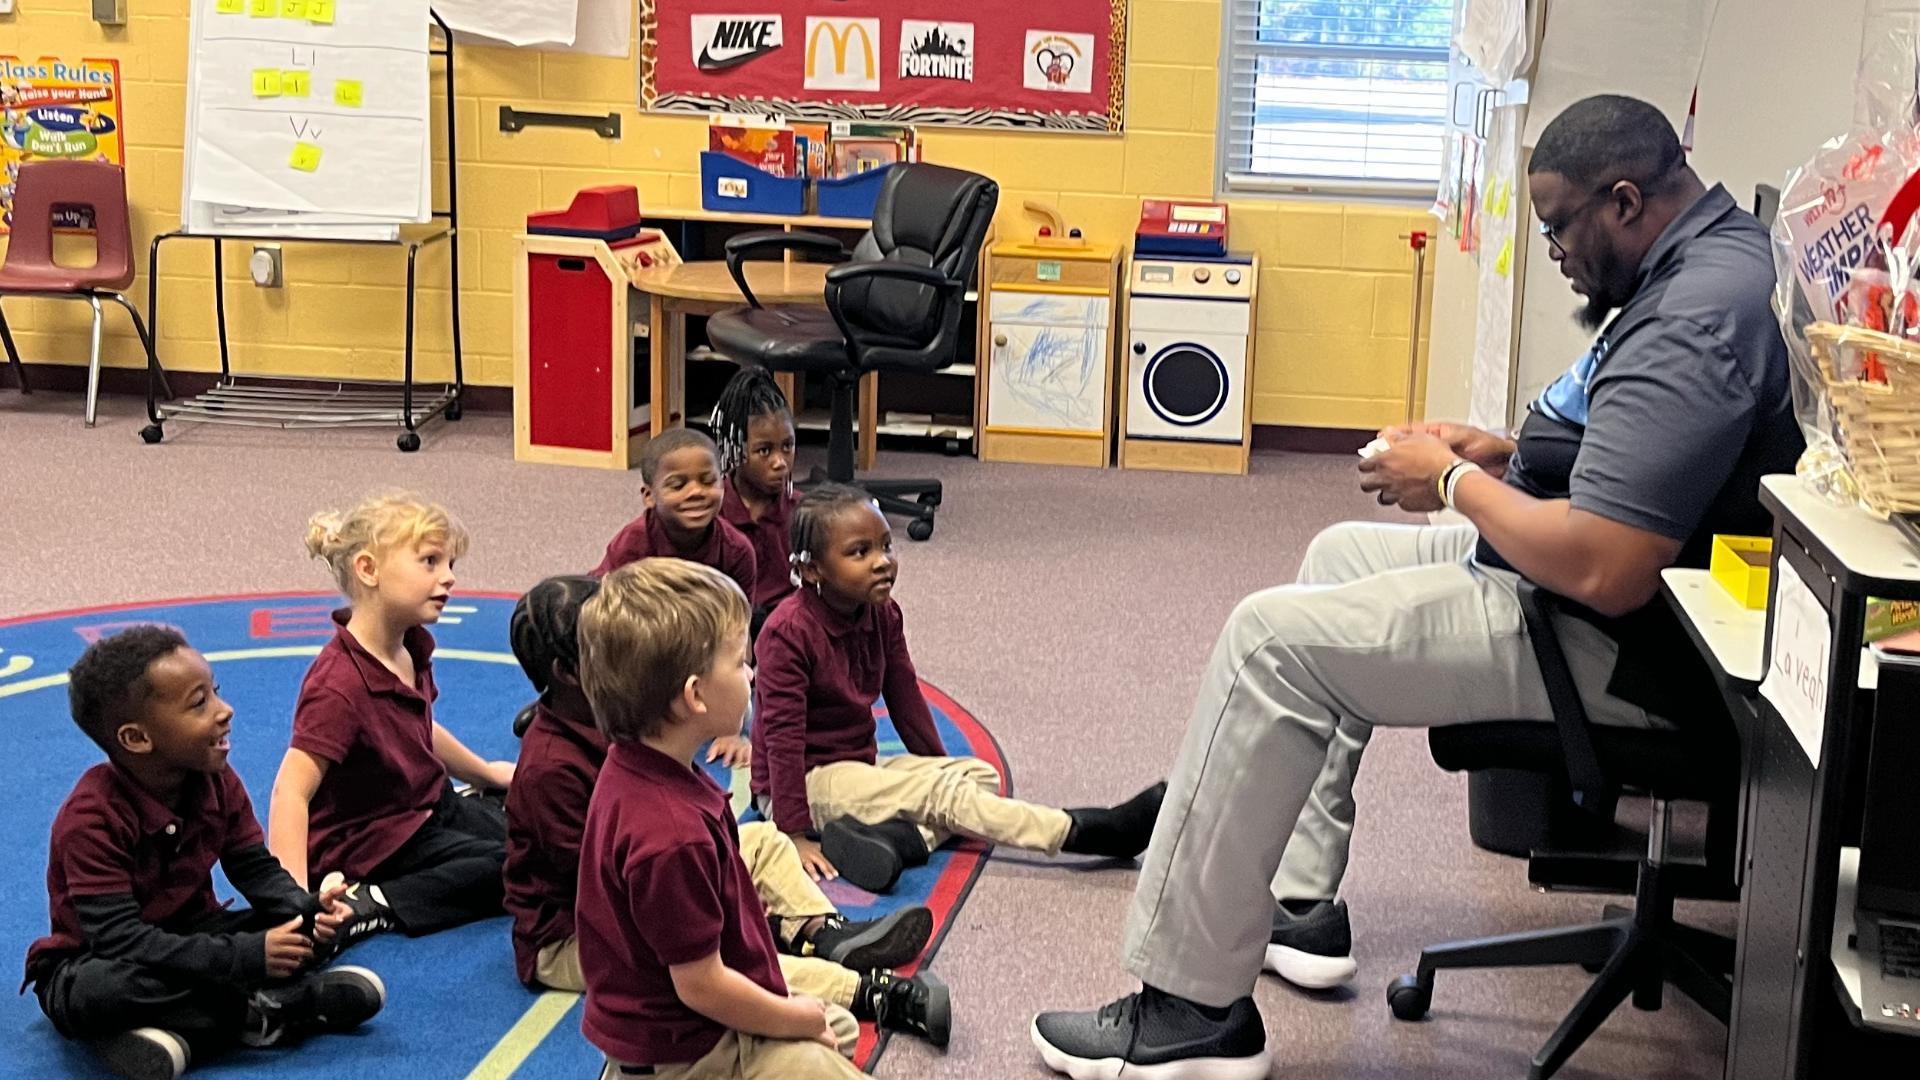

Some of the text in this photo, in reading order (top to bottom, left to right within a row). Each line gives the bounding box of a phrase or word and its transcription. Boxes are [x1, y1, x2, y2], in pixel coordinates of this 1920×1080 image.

[712, 20, 775, 49] NIKE
[0, 61, 112, 83] lass Rules
[901, 53, 972, 81] FORTNITE
[79, 87, 107, 100] Hand
[37, 109, 74, 124] Listen
[40, 130, 66, 141] Walk
[31, 141, 86, 153] Don't Run
[66, 210, 81, 225] Up
[1799, 203, 1874, 284] WEATHER
